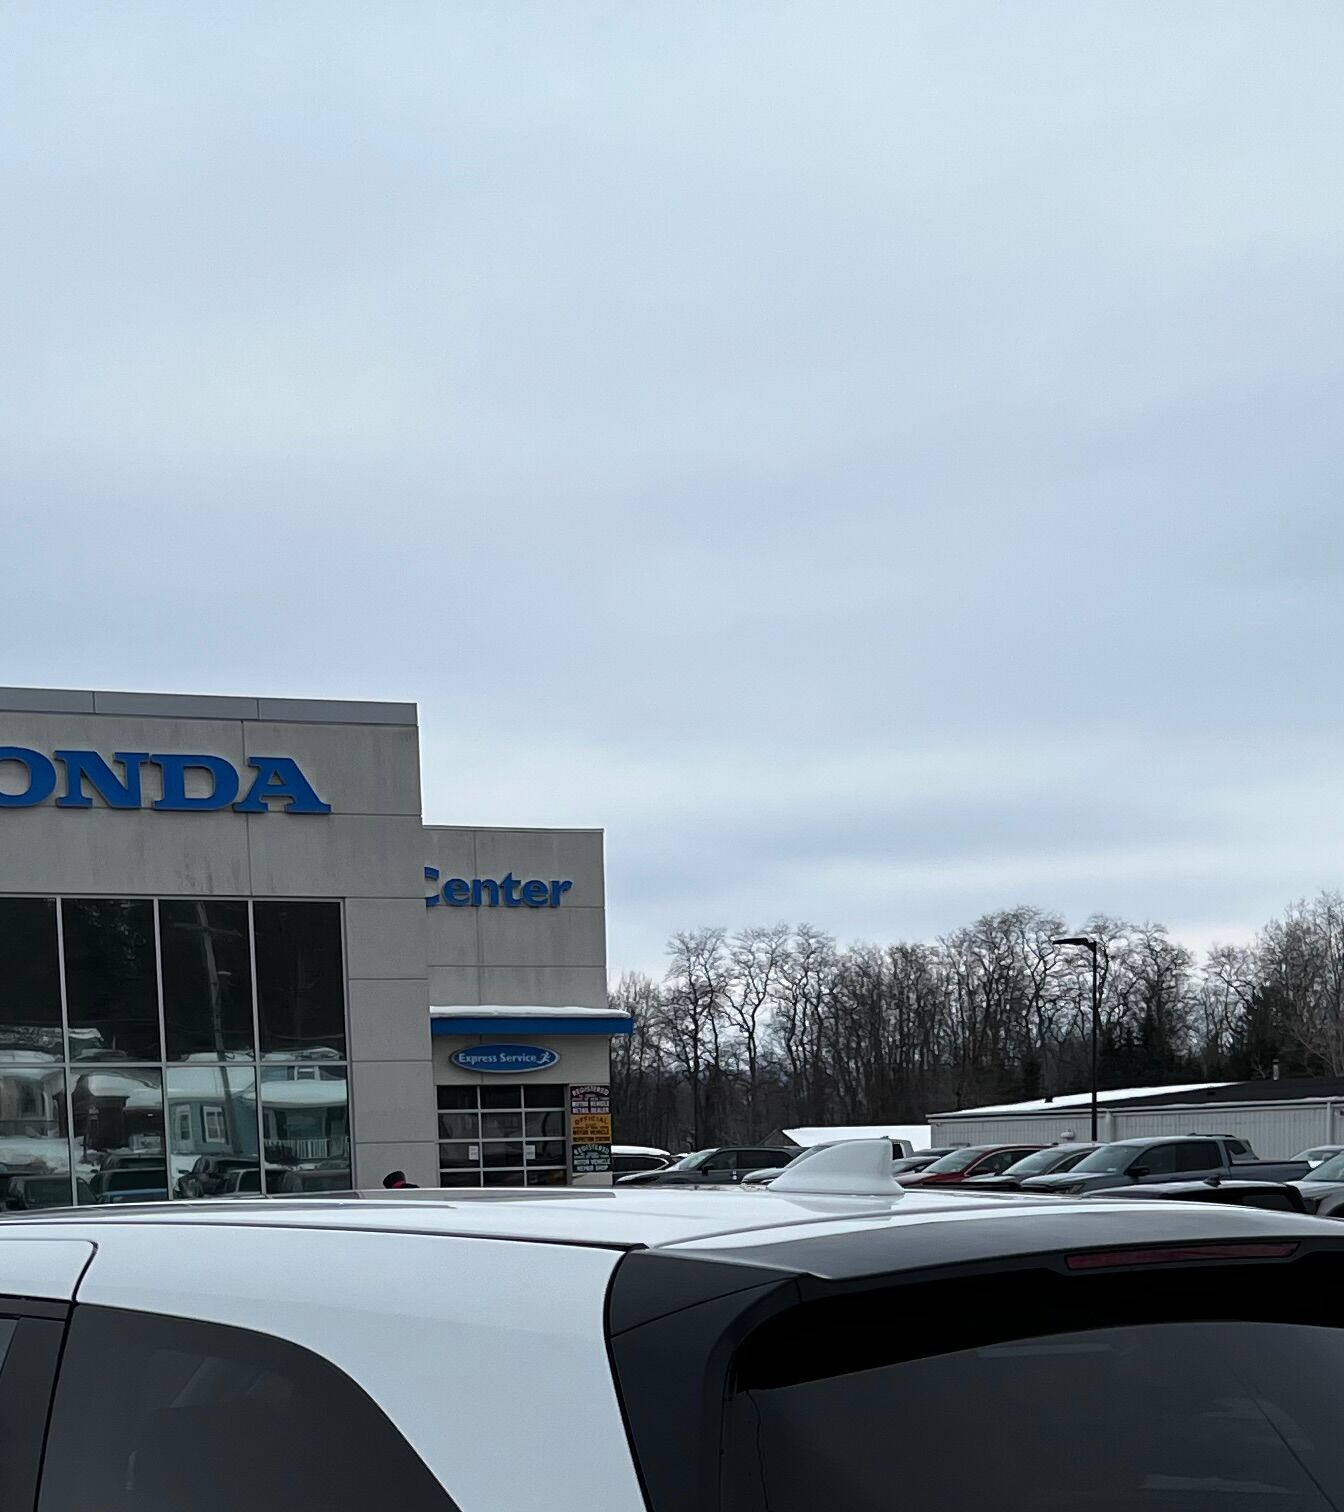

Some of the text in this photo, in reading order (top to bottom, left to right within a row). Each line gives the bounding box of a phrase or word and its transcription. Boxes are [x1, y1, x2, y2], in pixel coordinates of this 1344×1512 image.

[458, 1053, 537, 1065] Express Service
[572, 1086, 610, 1096] REGISTERED
[574, 1116, 608, 1125] OFFICIAL
[573, 1144, 610, 1155] REGISTERED
